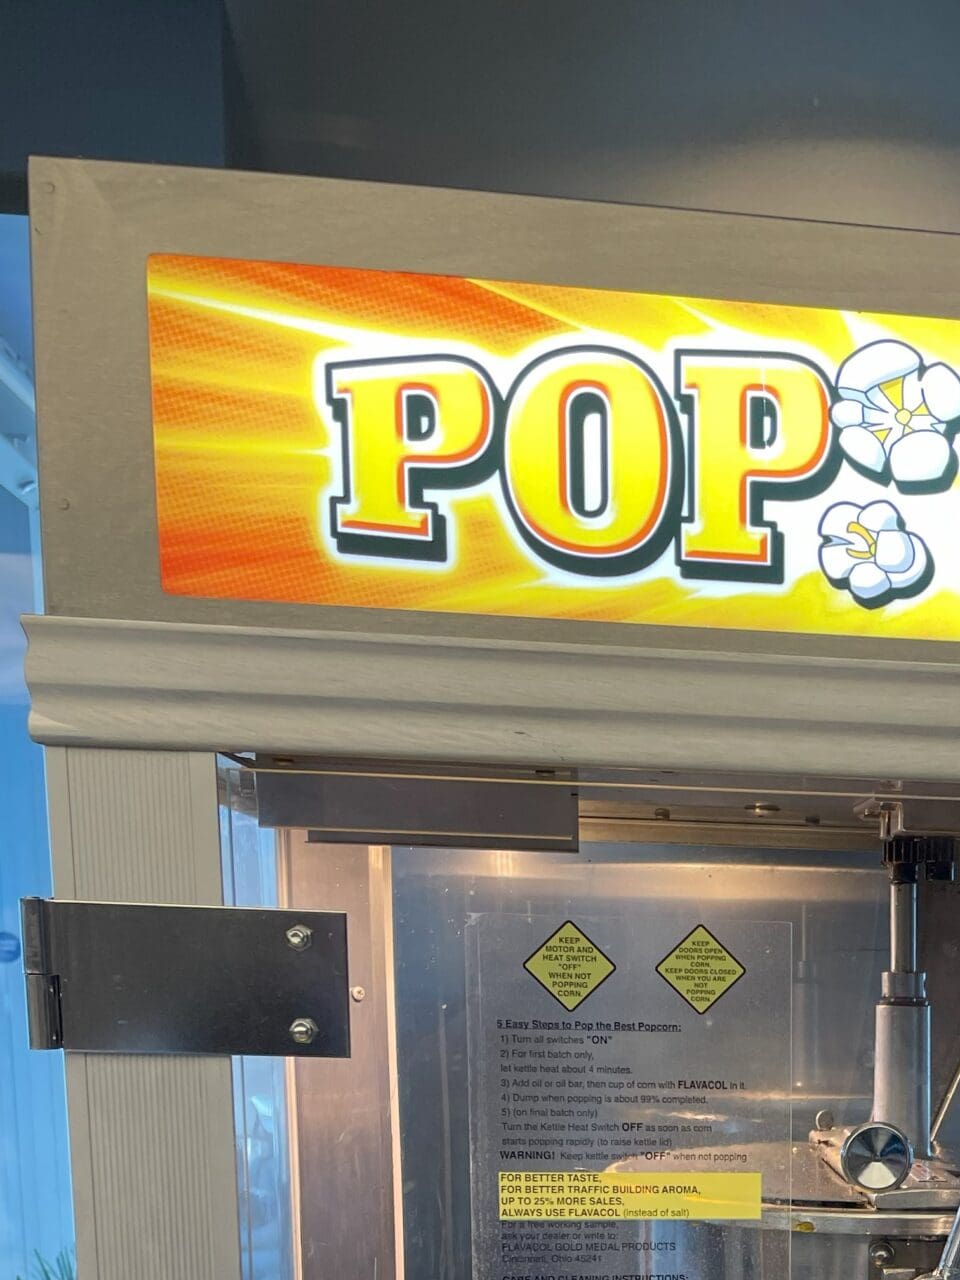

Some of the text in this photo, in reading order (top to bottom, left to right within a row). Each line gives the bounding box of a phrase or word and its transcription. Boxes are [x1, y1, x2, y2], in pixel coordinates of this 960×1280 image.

[325, 345, 843, 583] POP
[497, 1020, 502, 1029] 5
[506, 1020, 528, 1029] Easy
[532, 1020, 559, 1030] Steps
[575, 1022, 593, 1031] Pop
[596, 1022, 611, 1030] the
[614, 1022, 636, 1031] Best
[638, 1022, 682, 1032] Popcorn:
[501, 1035, 508, 1044] 1)
[512, 1035, 531, 1043] Turn
[547, 1036, 584, 1044] switches
[587, 1036, 612, 1044] "ON"
[500, 1050, 509, 1058] 2)
[512, 1050, 526, 1058] For
[529, 1050, 545, 1058] first
[575, 1052, 594, 1060] only,
[501, 1064, 511, 1072] let
[597, 1066, 632, 1074] minutes.
[678, 1081, 727, 1089] FLAVACOL
[622, 1123, 643, 1131] OFF
[500, 1151, 554, 1159] WARNING!
[642, 1152, 670, 1160] "OFF"
[501, 1174, 601, 1183] FOR BETTER TASTE,
[613, 1186, 659, 1194] BUILDING
[661, 1186, 701, 1194] AROMA,
[502, 1197, 514, 1205] UP
[518, 1197, 531, 1205] TO
[534, 1197, 553, 1205] 25%
[590, 1198, 624, 1206] SALES,
[624, 1208, 658, 1217] (instead
[671, 1209, 689, 1218] salt)
